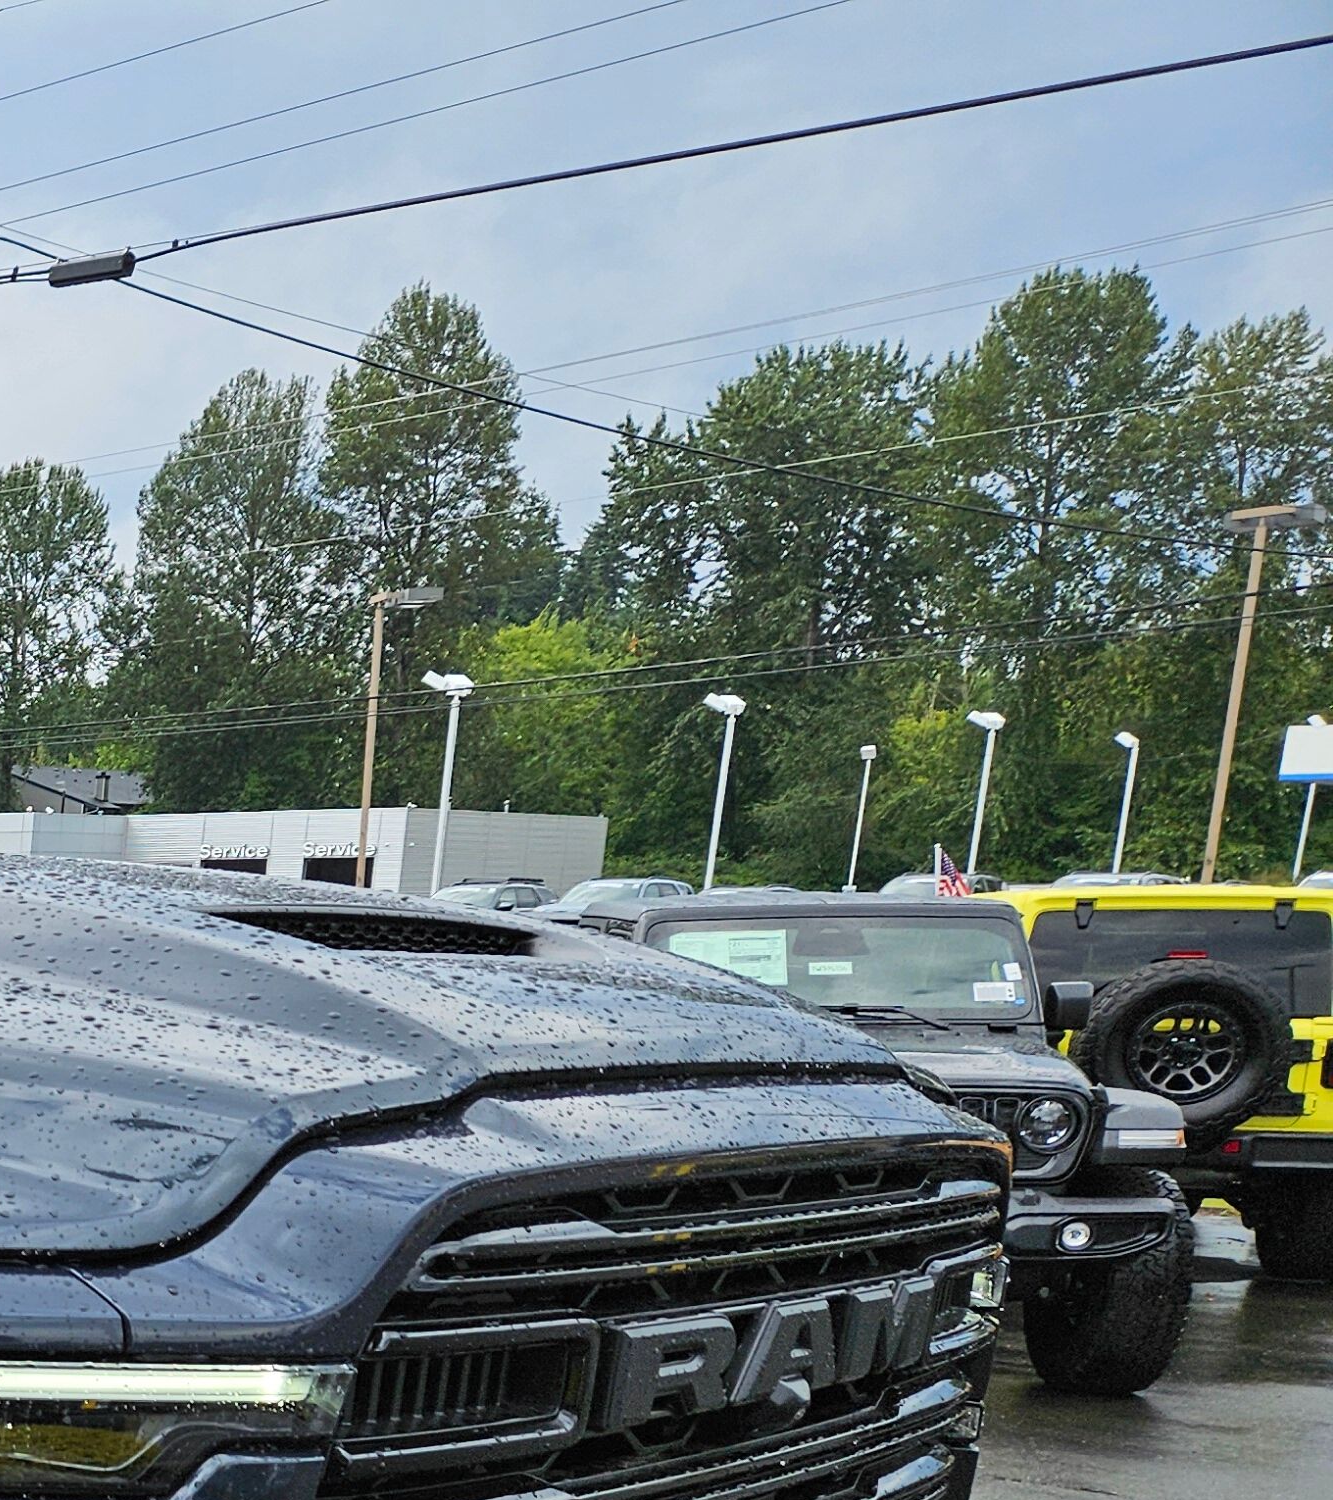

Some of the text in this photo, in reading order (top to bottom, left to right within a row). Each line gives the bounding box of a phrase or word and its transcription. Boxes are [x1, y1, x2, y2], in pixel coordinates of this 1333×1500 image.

[199, 843, 270, 859] Service
[302, 841, 378, 858] Service
[601, 1275, 936, 1431] RAM
